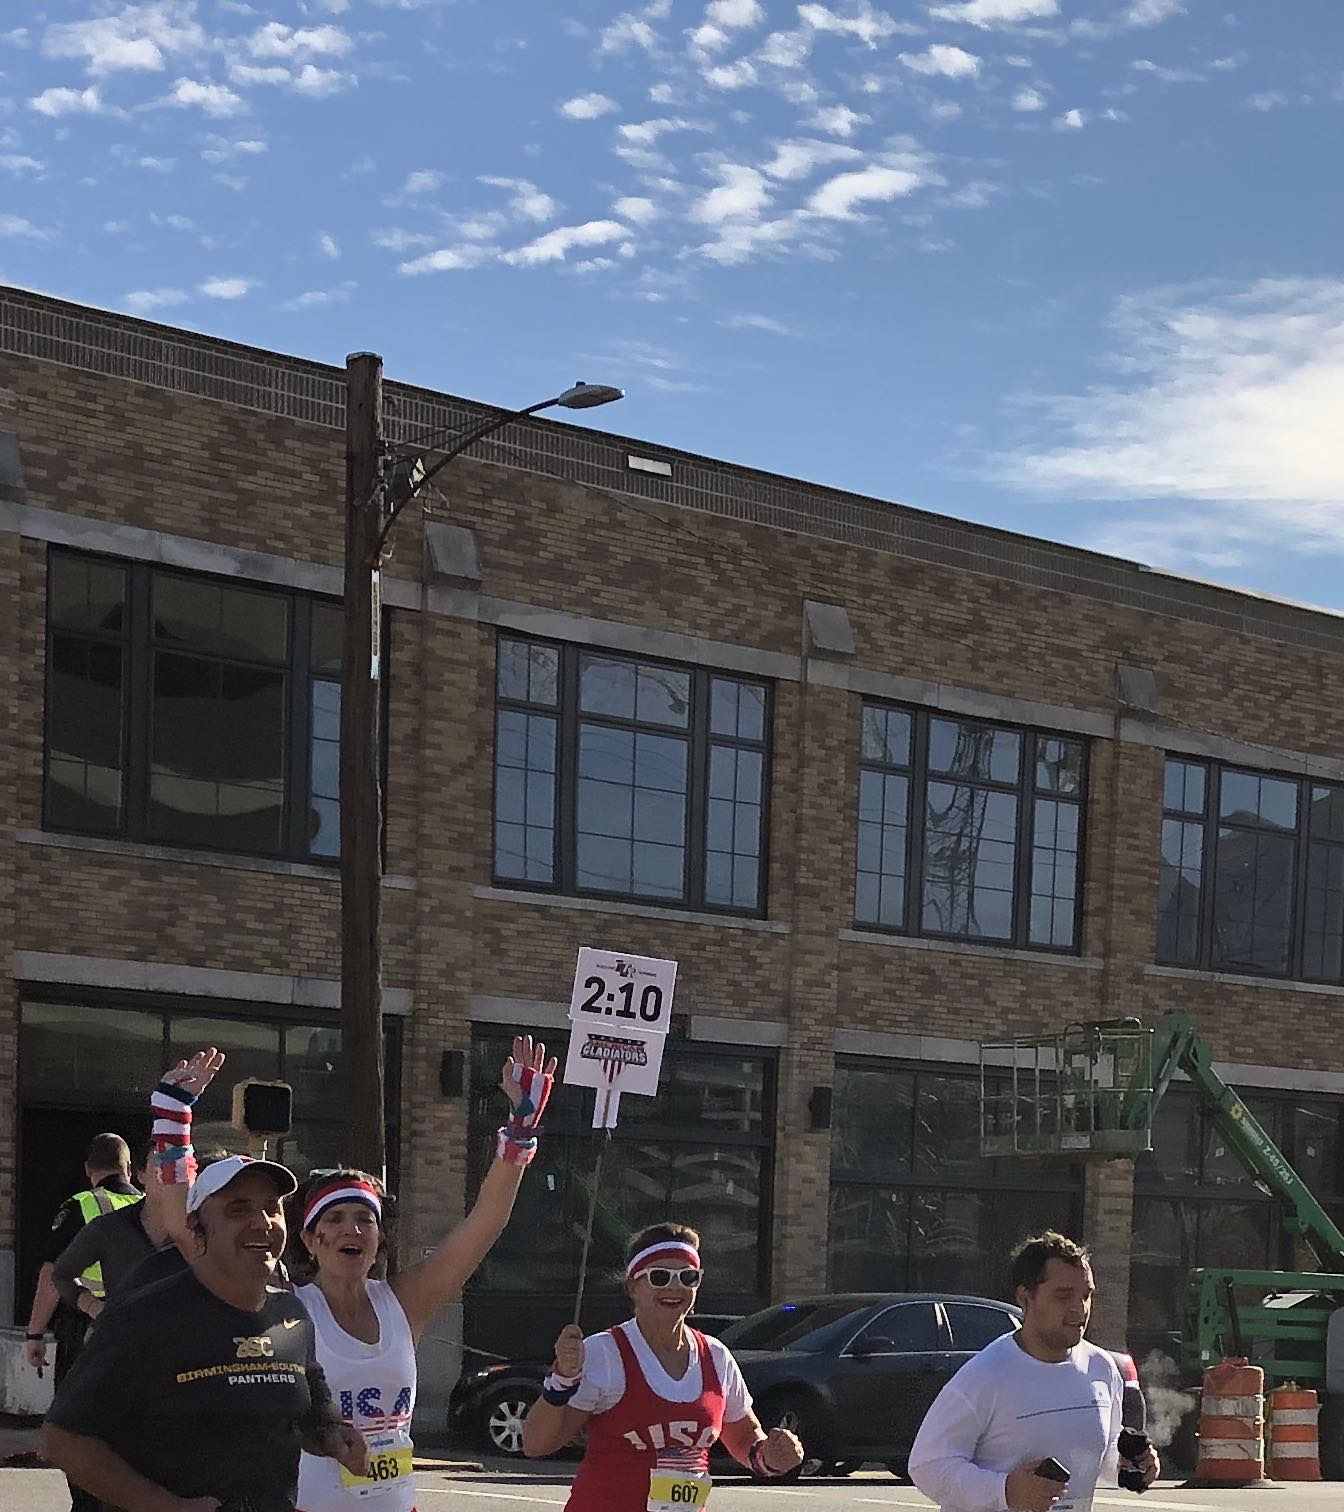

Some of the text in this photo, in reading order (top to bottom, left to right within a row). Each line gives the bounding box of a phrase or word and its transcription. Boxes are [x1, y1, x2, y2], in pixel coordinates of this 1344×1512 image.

[580, 976, 663, 1022] 2:10
[582, 1044, 647, 1064] GLADIATORS
[228, 1374, 296, 1386] PANTHERS
[367, 1458, 399, 1482] 463
[671, 1484, 699, 1504] 607
